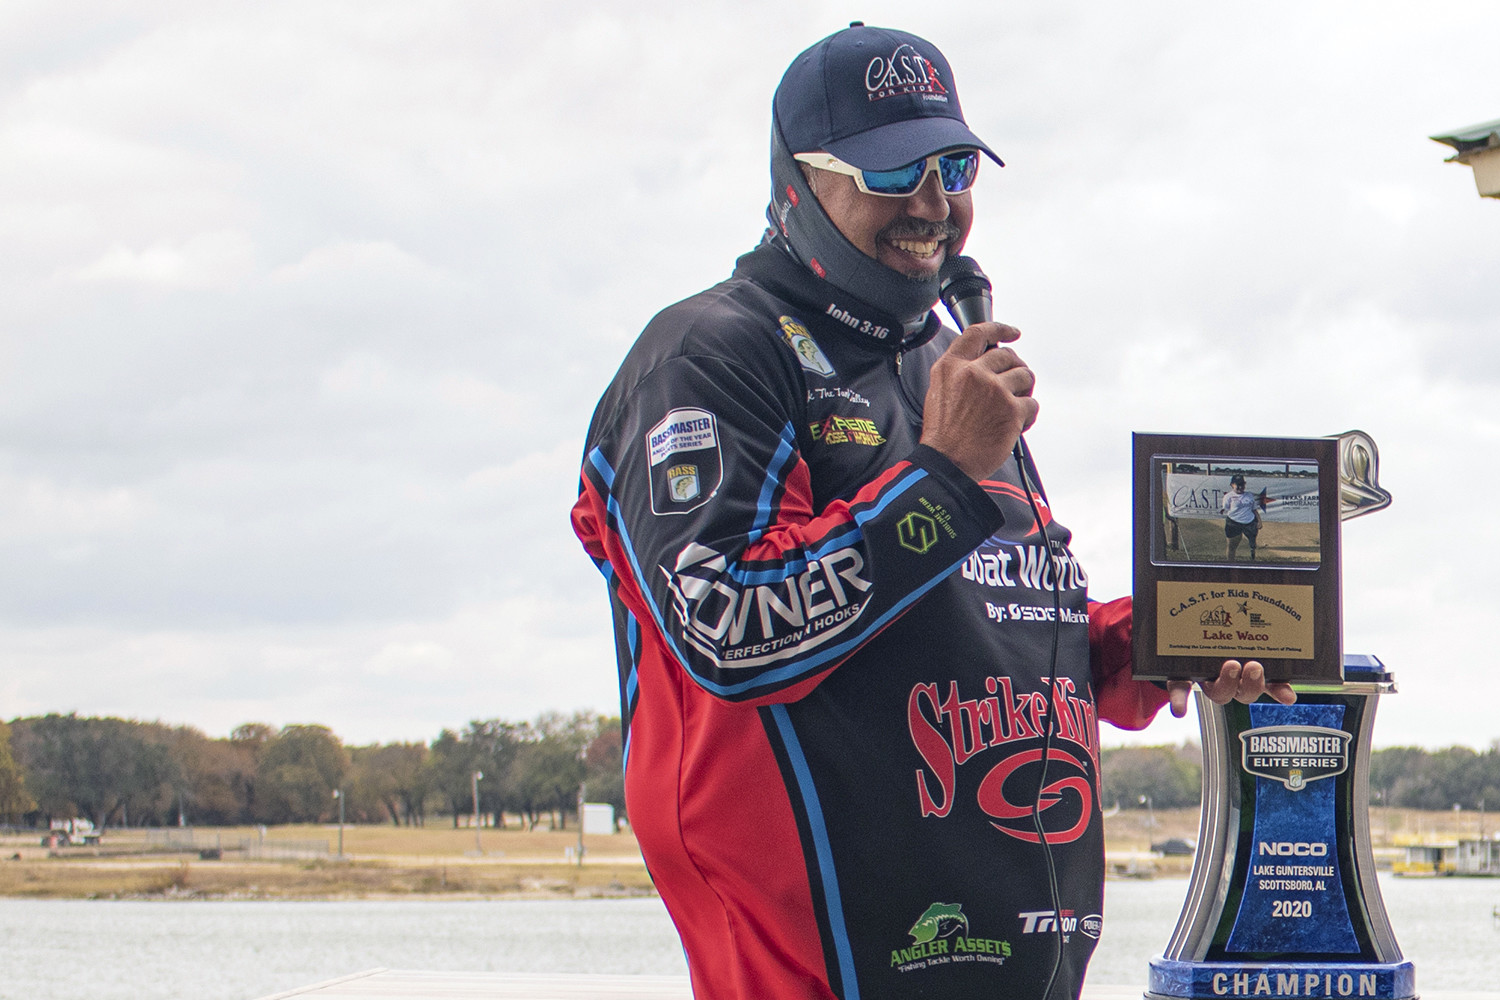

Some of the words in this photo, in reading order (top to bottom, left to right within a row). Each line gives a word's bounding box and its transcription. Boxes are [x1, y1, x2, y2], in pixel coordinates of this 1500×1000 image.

[867, 88, 896, 103] FOR
[903, 84, 933, 94] KIDS
[826, 303, 860, 329] John
[859, 319, 889, 341] 3:16
[651, 417, 711, 448] BASSMASTER
[694, 432, 712, 440] YEAR
[679, 440, 702, 448] SERIES
[986, 602, 1008, 622] By:
[1169, 592, 1209, 617] C.A.S.T.
[1210, 590, 1226, 599] for
[1227, 589, 1250, 598] Kids
[1251, 591, 1303, 622] Foundation
[722, 632, 803, 661] ERFECTION
[814, 603, 860, 633] HOOKS
[1203, 630, 1233, 640] Lake
[1235, 630, 1269, 641] Waco
[908, 677, 1053, 818] Strike
[1250, 736, 1341, 754] BASSMASTER
[1253, 758, 1289, 768] ELITE
[1291, 758, 1338, 769] SERIES
[1258, 841, 1328, 857] NOCO
[1253, 865, 1275, 876] LAKE
[1275, 865, 1335, 877] GUNTERSVILLE
[1259, 879, 1315, 892] SCOTTSBORO,
[1315, 880, 1327, 891] AL
[1272, 900, 1312, 918] 2020
[1018, 911, 1077, 934] Trion
[890, 939, 949, 967] ANGLER
[926, 955, 951, 967] Tackle
[951, 954, 975, 964] Worth
[1212, 972, 1377, 997] CHAMPION
